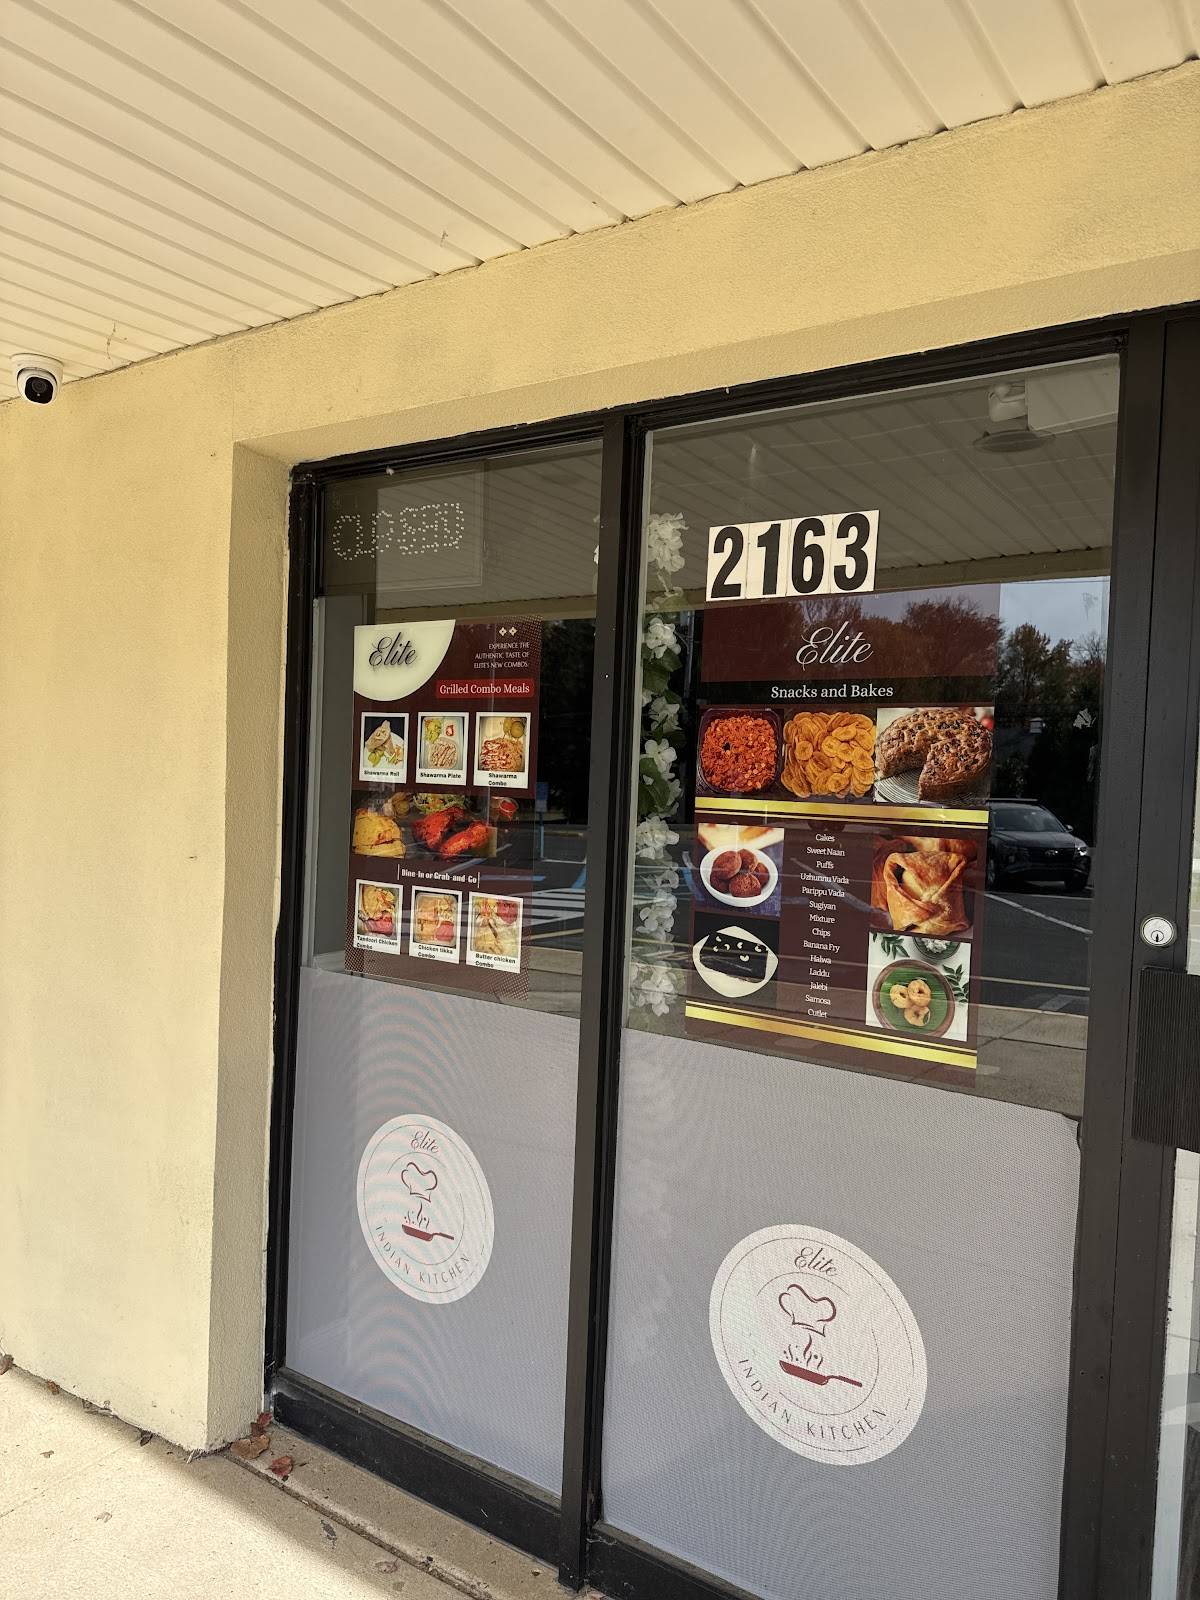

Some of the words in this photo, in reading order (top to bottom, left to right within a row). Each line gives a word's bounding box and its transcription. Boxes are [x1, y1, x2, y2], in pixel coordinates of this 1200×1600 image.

[710, 512, 871, 598] 2163
[519, 641, 530, 649] THE
[796, 621, 873, 671] Elite
[368, 632, 418, 670] Elite
[505, 651, 521, 659] TASTE
[439, 683, 469, 694] Grilled
[470, 683, 502, 694] Combo
[503, 682, 530, 693] Meals
[770, 685, 818, 699] Snacks
[820, 684, 847, 698] and
[850, 683, 894, 697] Bakes
[488, 772, 518, 780] Shawarma
[815, 833, 836, 842] Cakes
[806, 846, 827, 855] Sweet
[826, 848, 846, 857] Naan
[815, 860, 835, 870] Puffs
[401, 868, 425, 879] Dine-In
[831, 875, 850, 885] Vada
[801, 886, 828, 897] Parippu
[828, 888, 846, 898] Vada
[808, 900, 837, 911] Sugiyan
[809, 913, 836, 924] Mixture
[811, 927, 831, 939] Chips
[356, 935, 378, 944] Tandoori
[378, 938, 399, 946] Chicken
[355, 942, 373, 951] Combo
[417, 943, 440, 954] Chicken
[803, 940, 829, 951] Banana
[828, 943, 841, 954] Fry
[417, 951, 436, 960] Combo
[475, 952, 493, 962] Butter
[492, 955, 517, 965] chicken
[809, 954, 832, 965] Halwa
[474, 960, 495, 969] Combo
[809, 967, 831, 978] Laddu
[809, 981, 829, 992] Jalebi
[805, 994, 832, 1006] Samosa
[807, 1008, 828, 1019] Cutlet
[410, 1130, 439, 1154] Elite
[375, 1225, 411, 1275] INDIAN
[418, 1253, 470, 1283] KITCHEN
[793, 1246, 841, 1277] Elite
[738, 1358, 792, 1425] INDIAN
[806, 1407, 887, 1441] KITCHEN
